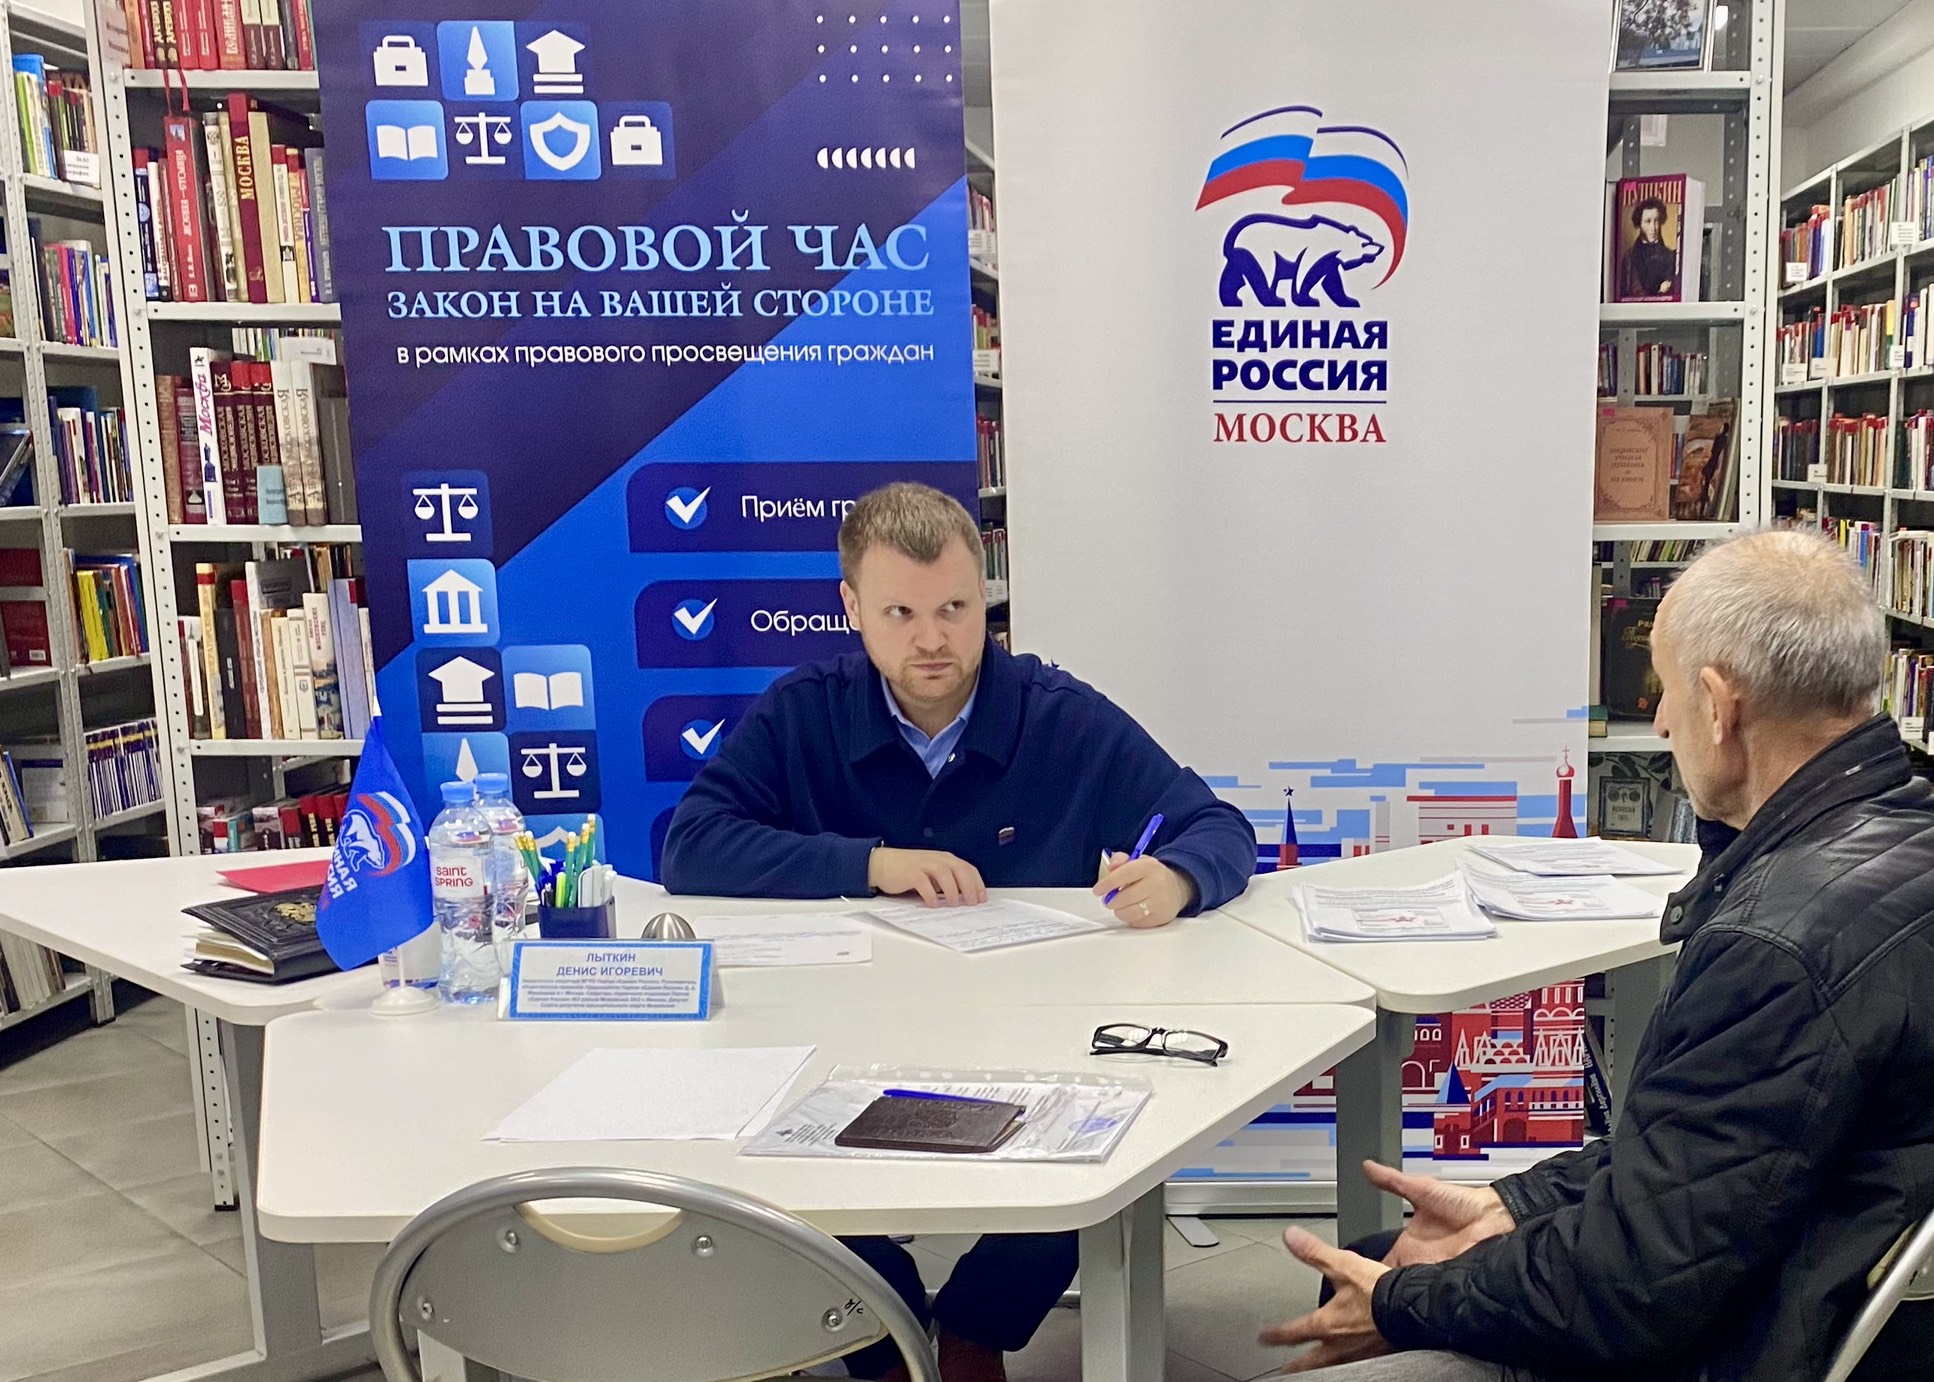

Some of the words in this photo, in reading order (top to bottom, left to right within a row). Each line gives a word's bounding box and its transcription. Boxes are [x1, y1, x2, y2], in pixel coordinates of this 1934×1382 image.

[235, 135, 256, 201] МОСКВА
[381, 210, 770, 273] ПРАВОВОЙ
[788, 223, 930, 272] ЧАС
[387, 290, 522, 319] ЗАКОН
[532, 289, 592, 318] НА
[601, 281, 743, 318] ВАШЕЙ
[753, 288, 935, 318] СТОРОНЕ
[1212, 319, 1388, 353] ЕДИНАЯ
[396, 347, 411, 365] в
[415, 346, 509, 367] рамках
[515, 345, 646, 368] правового
[651, 345, 822, 368] просвещения
[827, 343, 935, 365] граждан
[1212, 359, 1388, 391] РОССИЯ
[195, 373, 213, 437] Москва
[1213, 412, 1388, 443] МОСКВА
[741, 495, 825, 522] Приём
[831, 498, 857, 519] гр
[750, 610, 861, 636] Обращ
[556, 966, 598, 977] ДЕНИС
[600, 966, 664, 977] ИГОРЕВИЧ
[586, 952, 637, 963] ЛЫТКИН
